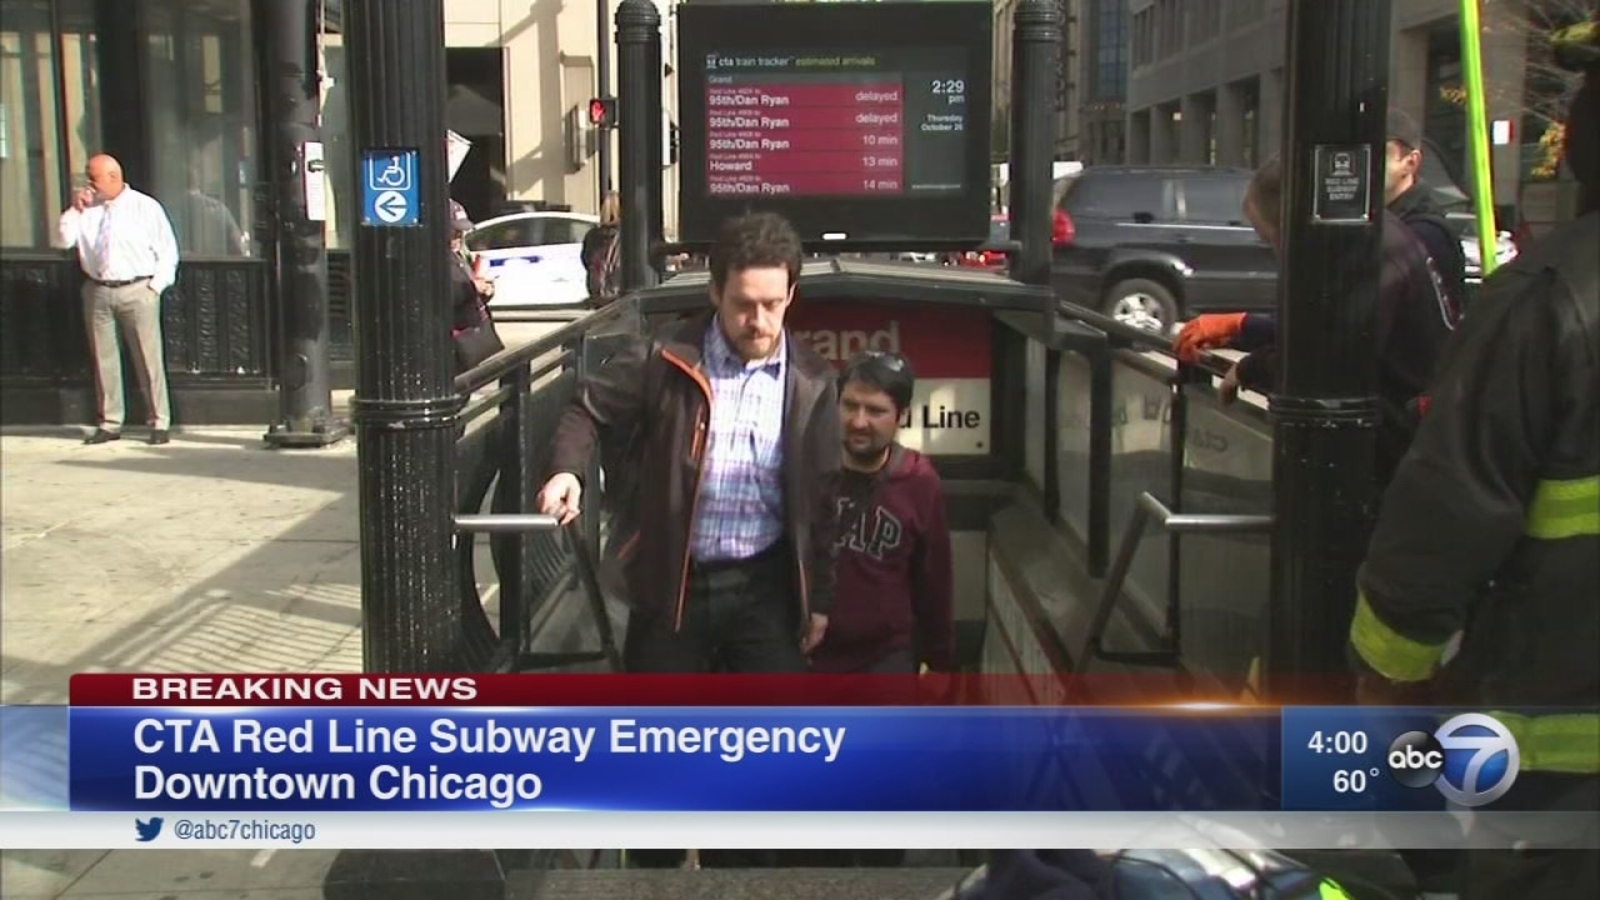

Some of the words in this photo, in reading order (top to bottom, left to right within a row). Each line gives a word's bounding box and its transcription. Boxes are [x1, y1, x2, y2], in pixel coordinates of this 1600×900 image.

[718, 57, 734, 66] cta
[735, 56, 757, 66] train
[795, 56, 841, 66] estimated
[842, 56, 876, 66] arrivals
[708, 75, 733, 84] Grand
[932, 79, 965, 94] 2:29
[709, 95, 759, 106] 95th/Dan
[760, 95, 790, 107] Ryan
[855, 91, 898, 102] delayed
[948, 95, 965, 105] pm
[709, 117, 759, 128] 95th/Dan
[760, 117, 790, 129] Ryan
[855, 113, 898, 125] delayed
[926, 114, 962, 123] Thursday
[920, 123, 952, 131] October
[709, 138, 759, 149] 95th/Dan
[760, 138, 790, 150] Ryan
[863, 135, 876, 145] 10
[878, 135, 898, 145] min
[709, 160, 752, 171] Howard
[863, 156, 876, 167] 13
[878, 157, 898, 167] min
[709, 183, 759, 194] 95th/Dan
[760, 183, 790, 195] Ryan
[863, 179, 876, 190] 14
[878, 180, 898, 190] min
[794, 320, 900, 361] rand
[923, 405, 981, 429] Line
[832, 497, 902, 560] AP
